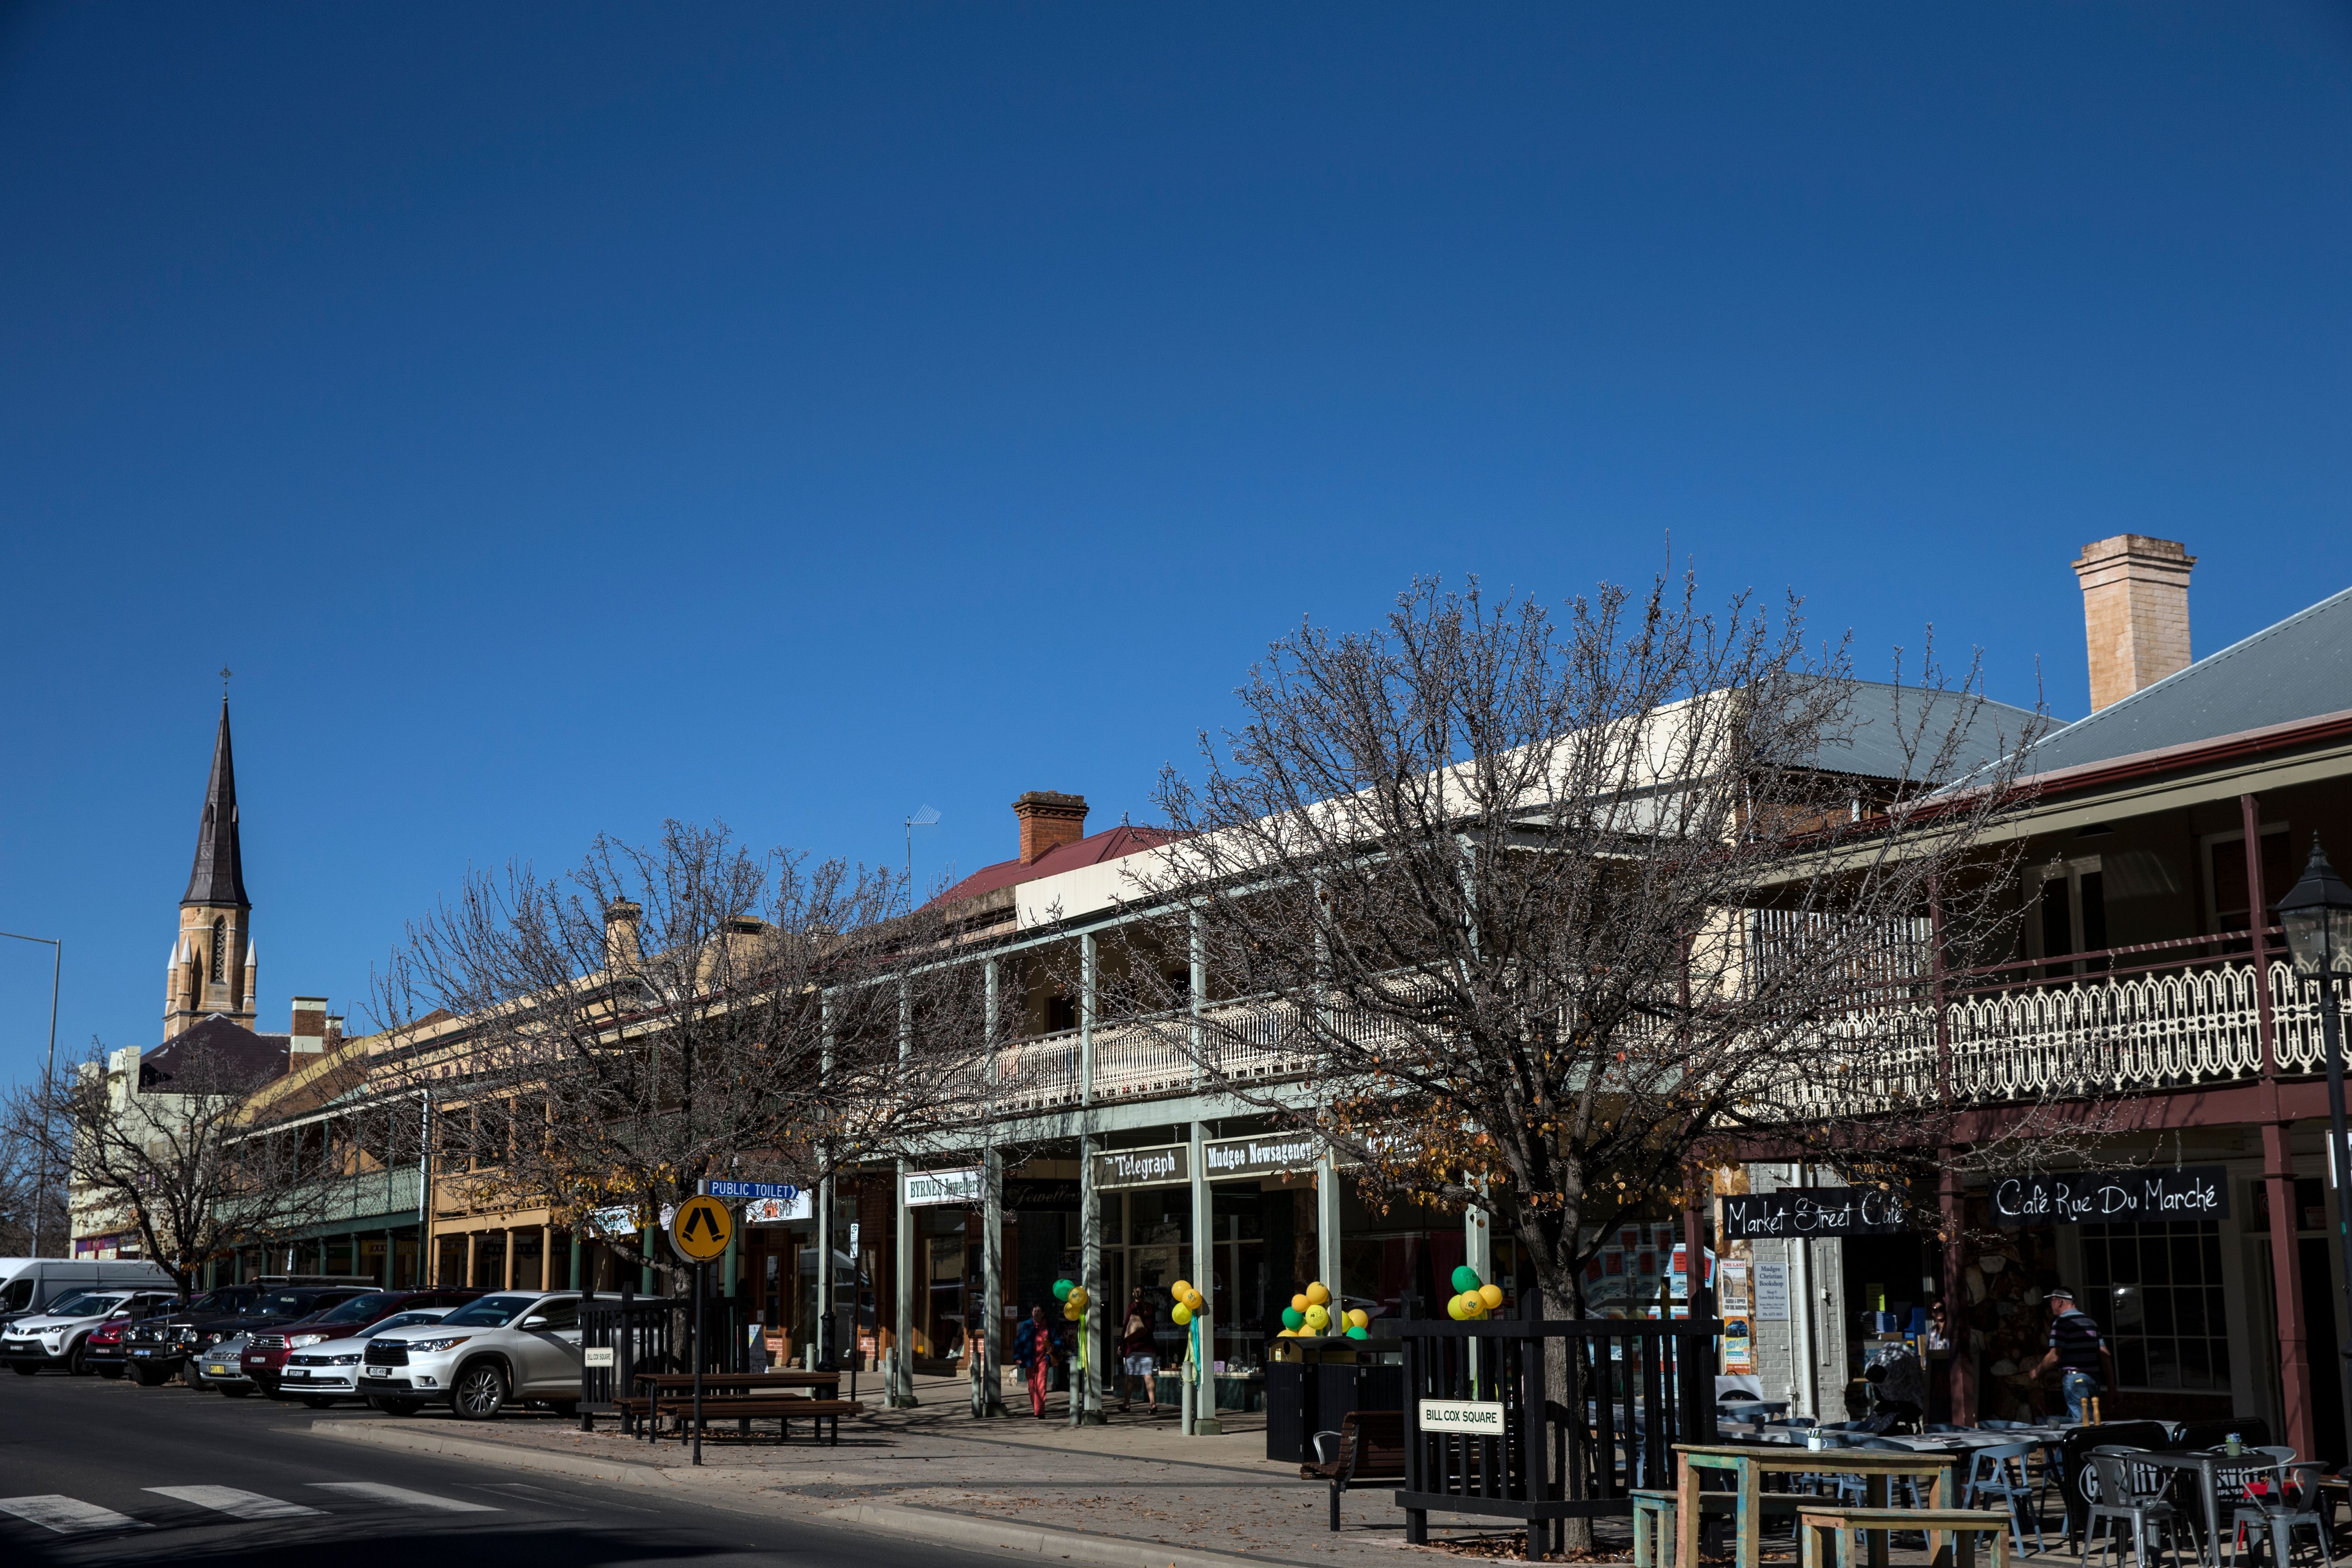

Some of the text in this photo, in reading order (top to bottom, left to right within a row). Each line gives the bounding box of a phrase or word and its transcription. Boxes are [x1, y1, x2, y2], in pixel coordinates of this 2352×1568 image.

[1115, 1150, 1176, 1180] Telegraph
[1207, 1142, 1312, 1170] Mudgee Newsagency
[712, 1182, 789, 1197] PUBLIC TOILET
[910, 1177, 980, 1198] BYRNES Jewellers
[1997, 1177, 2218, 1221] Café Rue Du Marché
[1728, 1201, 1792, 1235] Market
[1794, 1197, 1851, 1230] Street
[369, 1244, 387, 1253] XXX
[1426, 1409, 1497, 1424] BILL COX SQUARE
